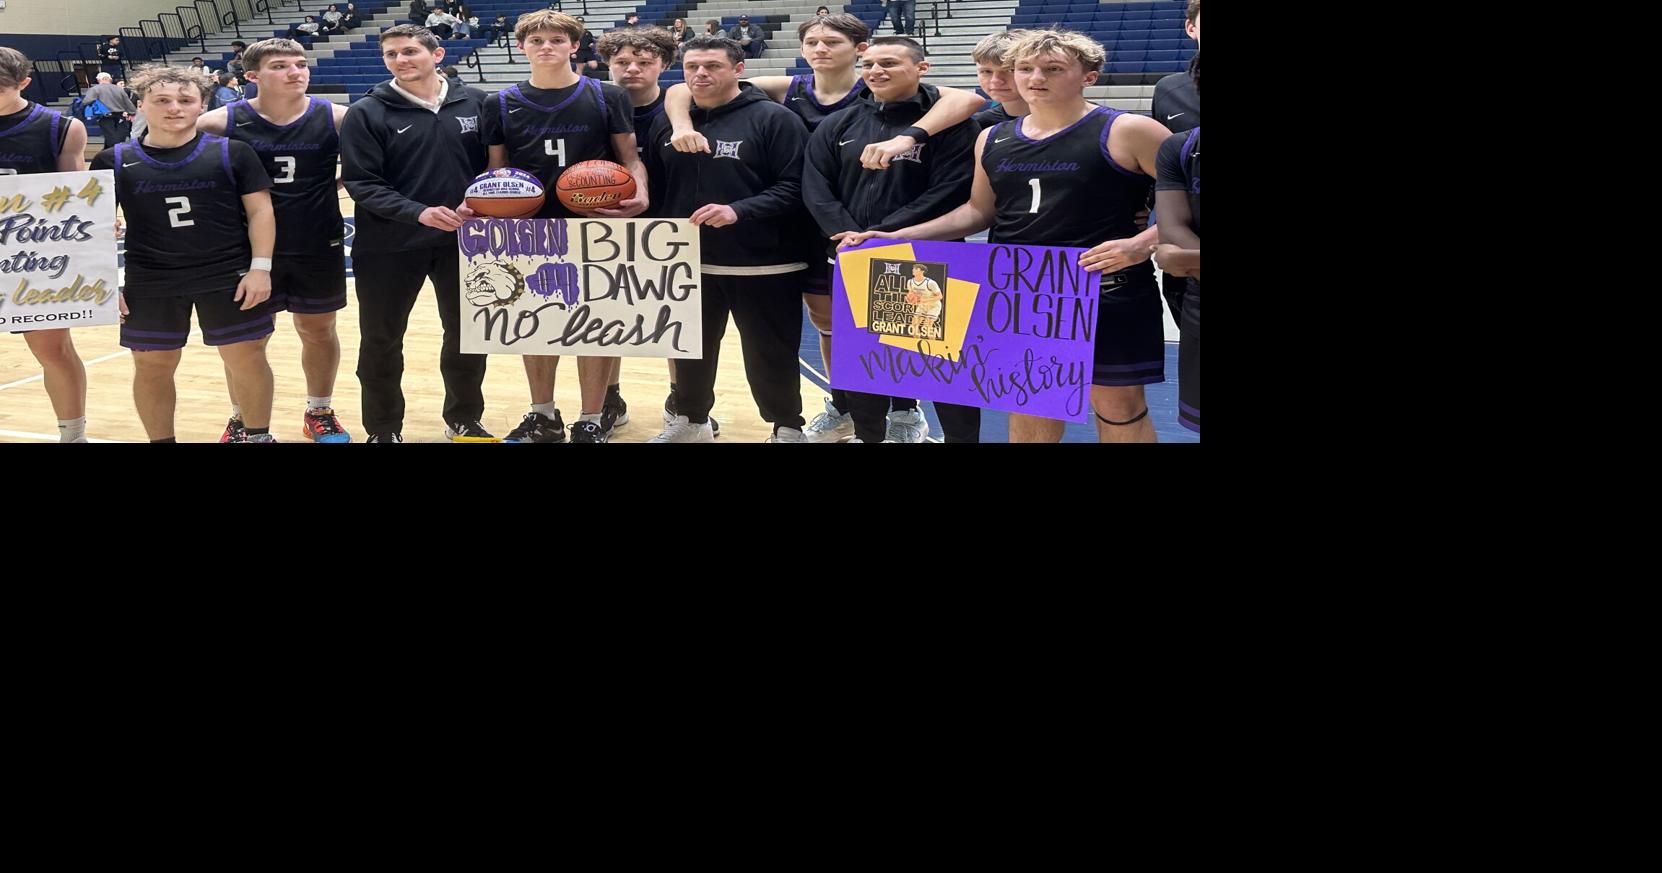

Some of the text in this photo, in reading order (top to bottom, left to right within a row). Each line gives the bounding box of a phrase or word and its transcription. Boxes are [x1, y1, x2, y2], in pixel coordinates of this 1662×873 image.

[544, 138, 566, 167] 4
[994, 157, 1080, 173] Hermiston
[273, 155, 296, 184] 3
[132, 179, 217, 195] Hermiston
[479, 181, 501, 190] GRANT
[1028, 178, 1041, 213] 1
[164, 195, 195, 228] 2
[0, 213, 95, 246] Points
[580, 219, 690, 263] BIG
[581, 260, 698, 306] DAWG
[874, 273, 909, 292] ALL
[11, 309, 93, 324] RECORD!!
[547, 304, 689, 352] leash
[872, 320, 942, 338] GRANT OLSEN
[985, 290, 1095, 343] OLSEN
[967, 347, 1091, 418] history
